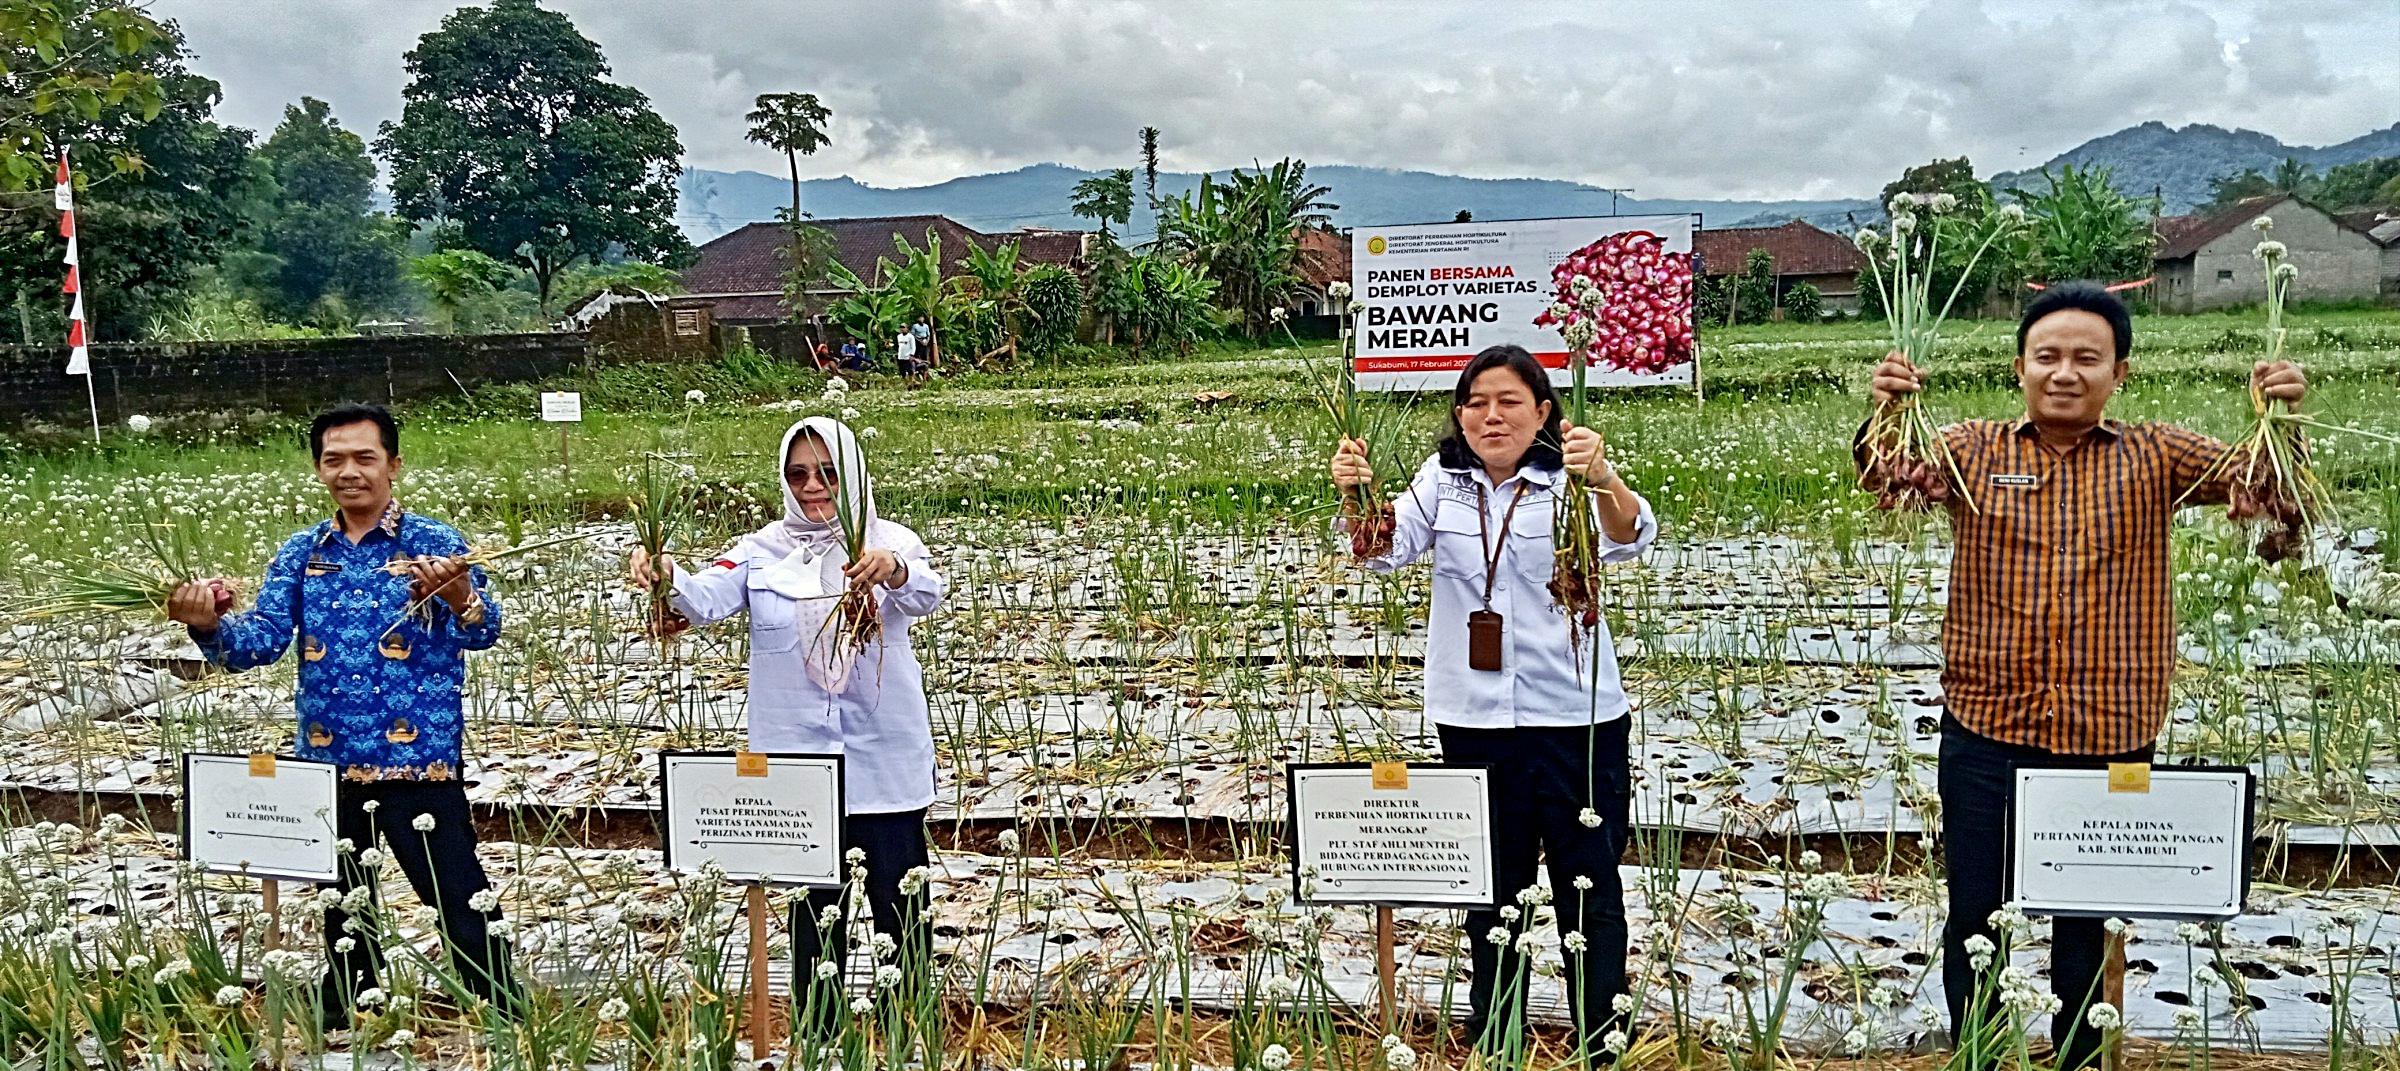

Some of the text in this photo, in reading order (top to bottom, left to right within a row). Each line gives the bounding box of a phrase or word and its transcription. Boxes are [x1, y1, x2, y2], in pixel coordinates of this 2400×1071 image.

[1368, 266, 1514, 283] PANEN BERSAMA
[1368, 281, 1537, 298] DEMPLOT VARIETAS
[1368, 303, 1498, 326] BAWANG
[1368, 327, 1469, 349] MERAH
[735, 798, 772, 806] KEPALA
[1363, 800, 1419, 808] DIREKTUR
[249, 803, 278, 812] CAMAT
[226, 812, 302, 824] KEC. KEBONPEDES
[700, 808, 807, 818] PUSAT PERLINDUNGAN
[1386, 812, 1471, 820] HORTIKULTURA
[695, 819, 742, 827] VARIETAS
[744, 819, 790, 828] TANAMAN
[2083, 820, 2174, 830] KEPALA DINAS
[701, 829, 808, 839] PERIZINAN PERTANIAN
[1359, 826, 1428, 834] MERANGKAP
[2033, 832, 2224, 844] PERTANIAN TANAMAN PANGAN
[1329, 841, 1459, 849] PLT. STAF AHLI MENTERI
[2078, 845, 2177, 855] KAB. SUKABUMI
[1320, 852, 1470, 861] BIDANG PERDAGANGAN DAN
[1321, 864, 1471, 873] HUBUNGAN INTERNASIONAL
